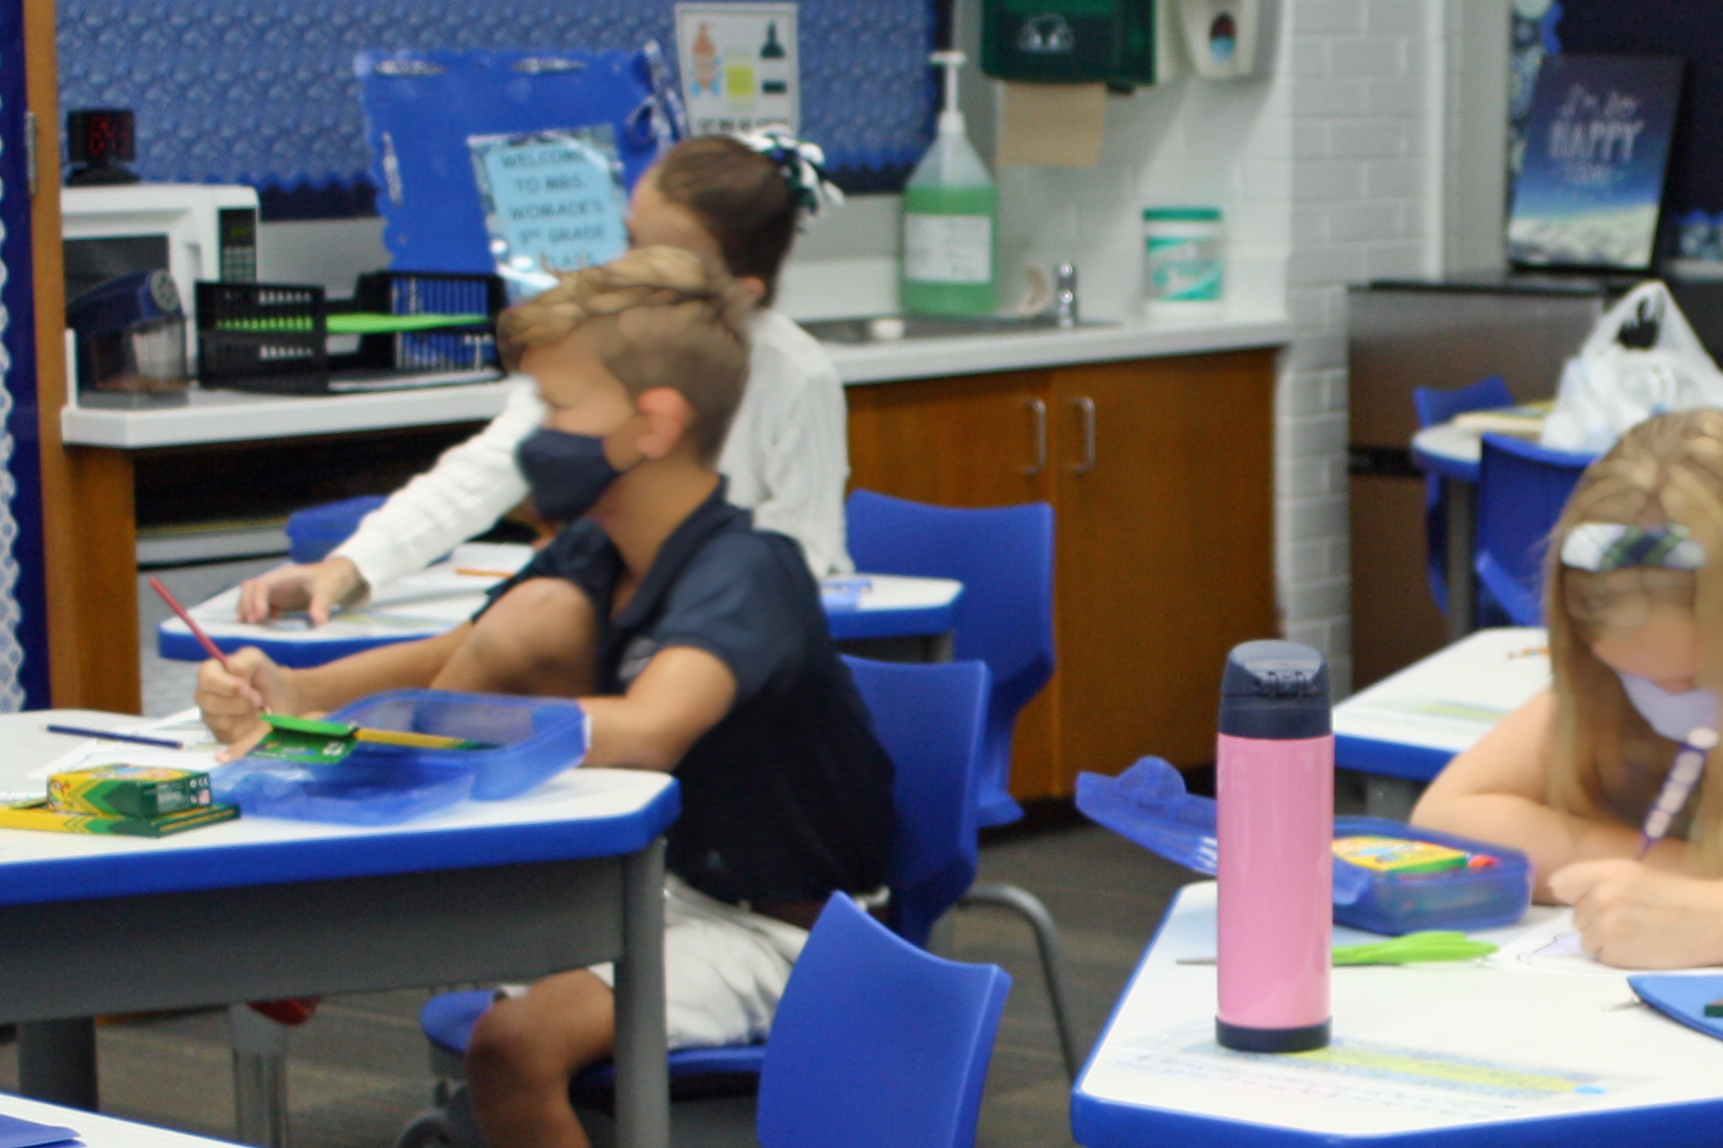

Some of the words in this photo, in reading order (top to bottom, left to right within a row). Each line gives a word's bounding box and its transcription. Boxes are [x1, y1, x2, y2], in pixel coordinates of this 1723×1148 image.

[1548, 120, 1645, 162] HAPPY
[514, 176, 540, 193] TO
[548, 221, 605, 244] GRADE
